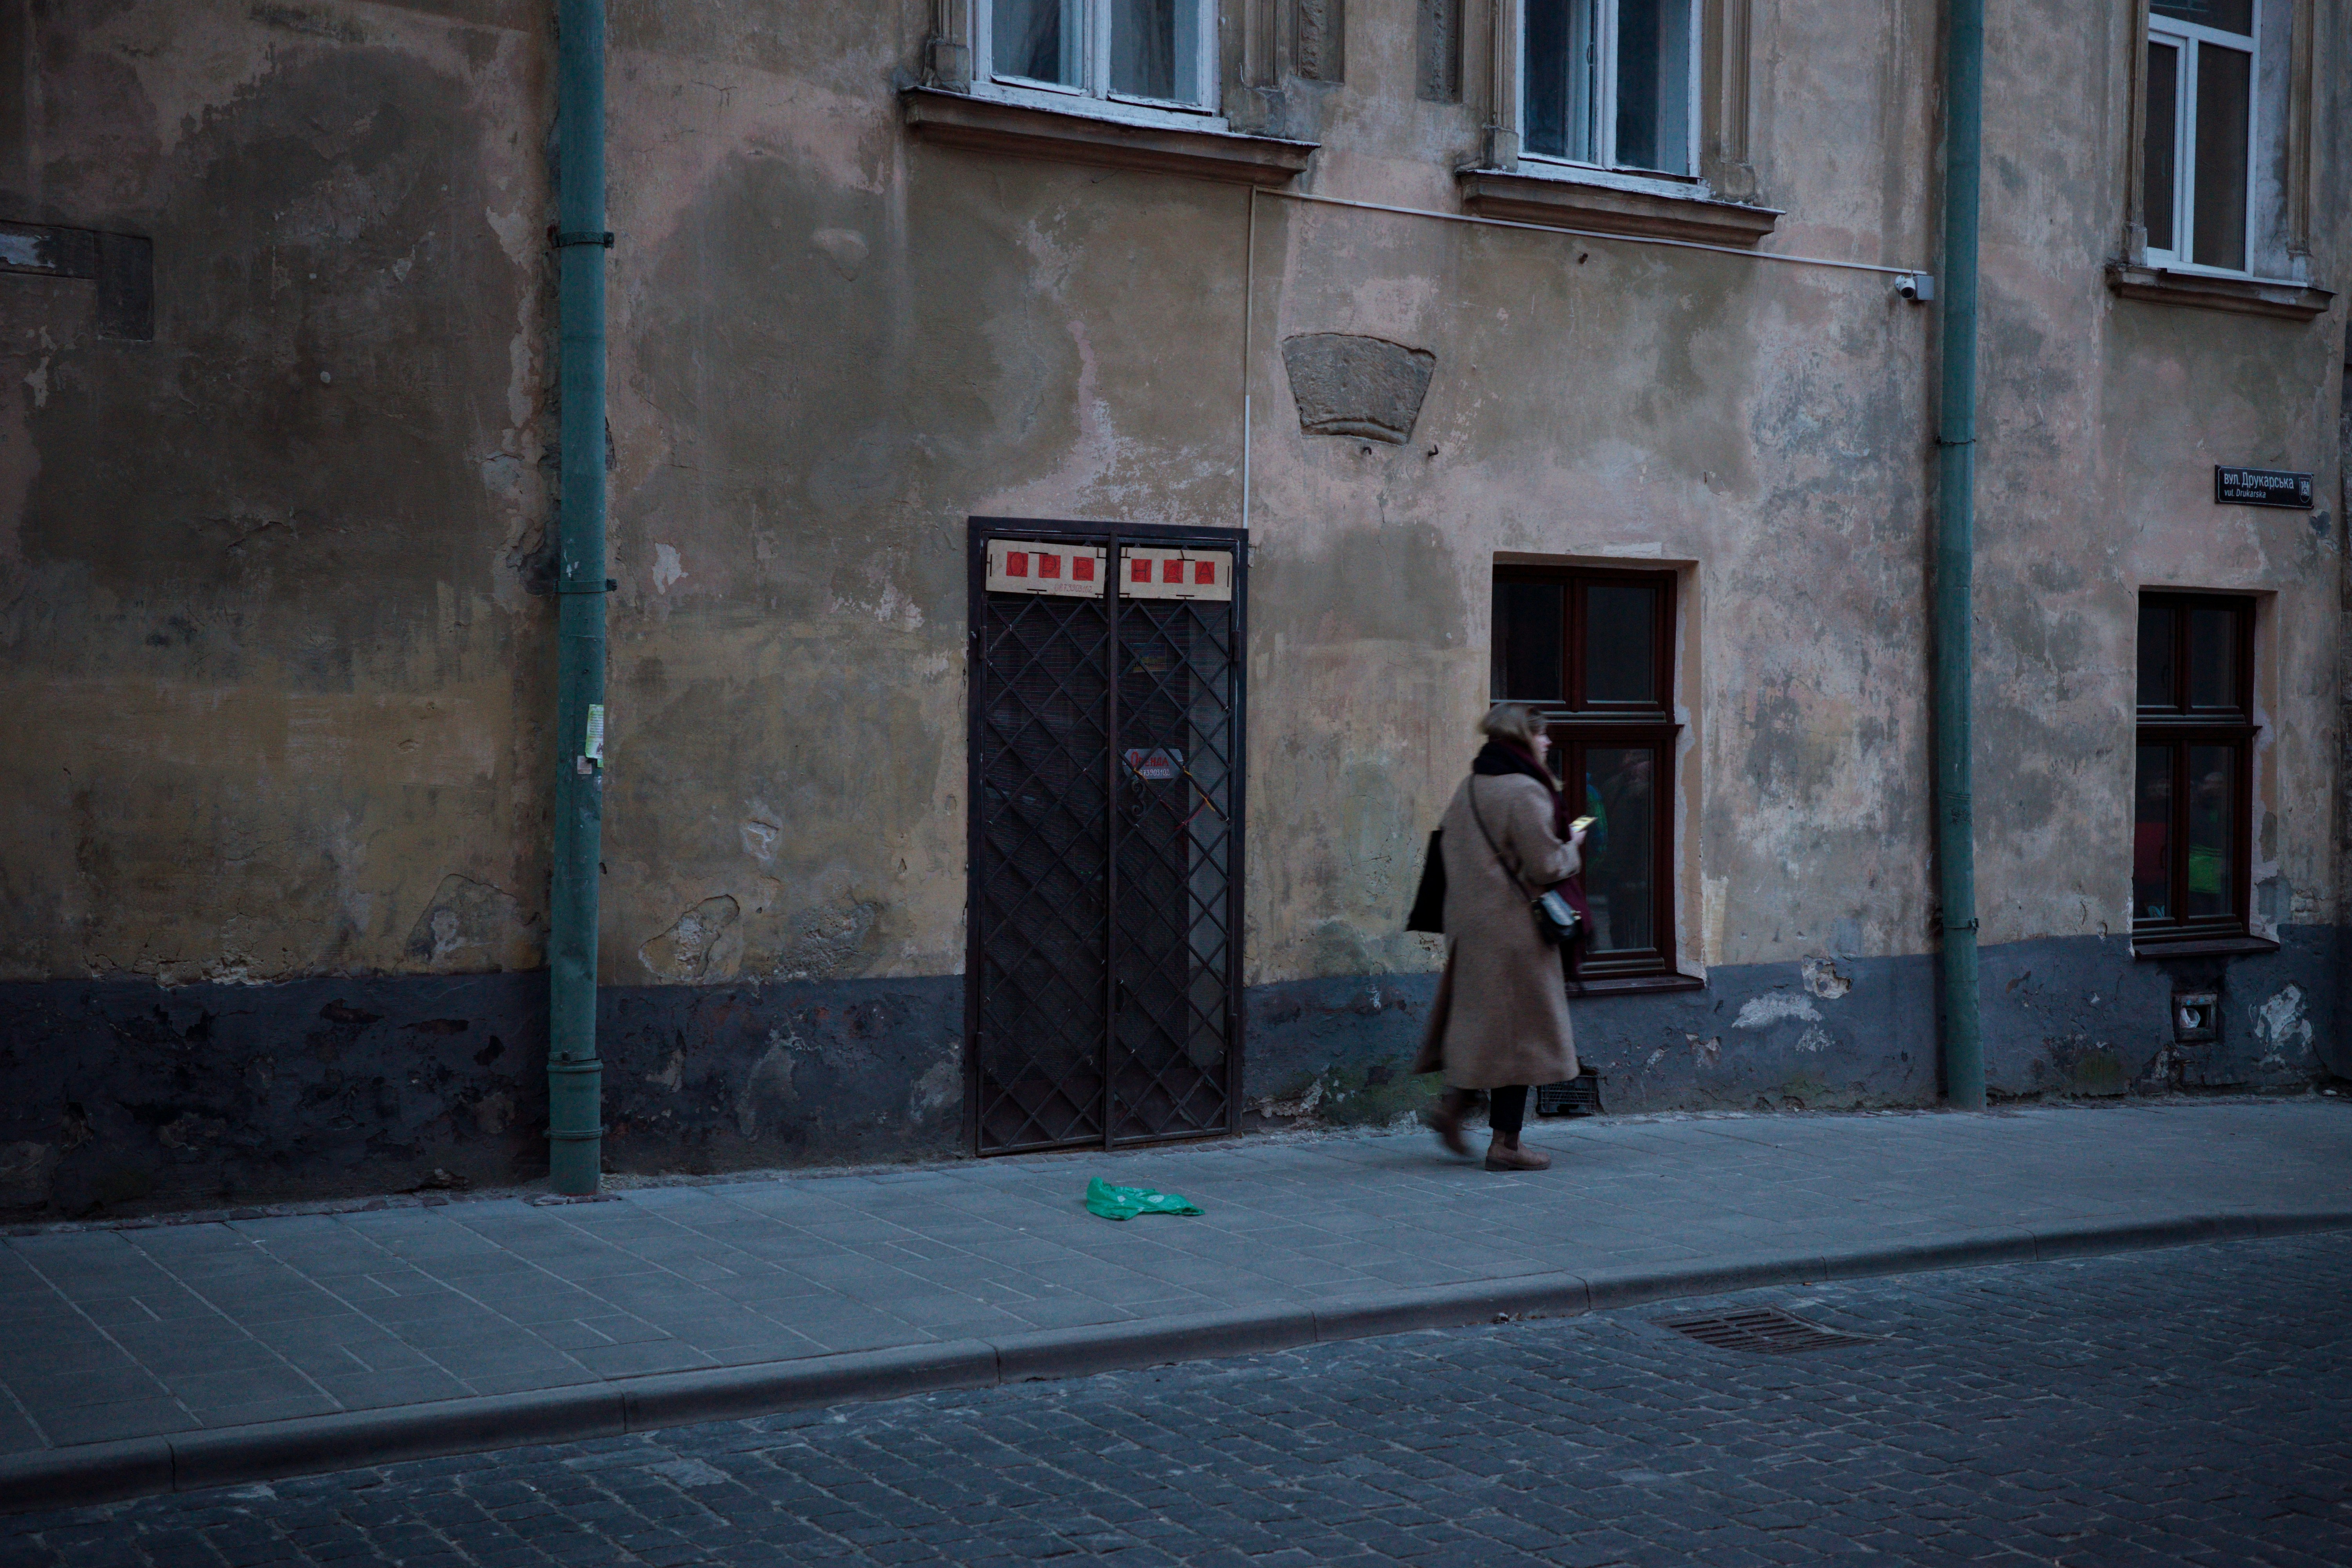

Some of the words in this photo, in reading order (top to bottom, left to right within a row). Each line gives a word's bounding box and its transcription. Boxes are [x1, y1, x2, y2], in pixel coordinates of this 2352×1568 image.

[2224, 473, 2240, 485] вул.
[2241, 472, 2294, 490] Друкарська
[2236, 488, 2267, 498] Drukarska
